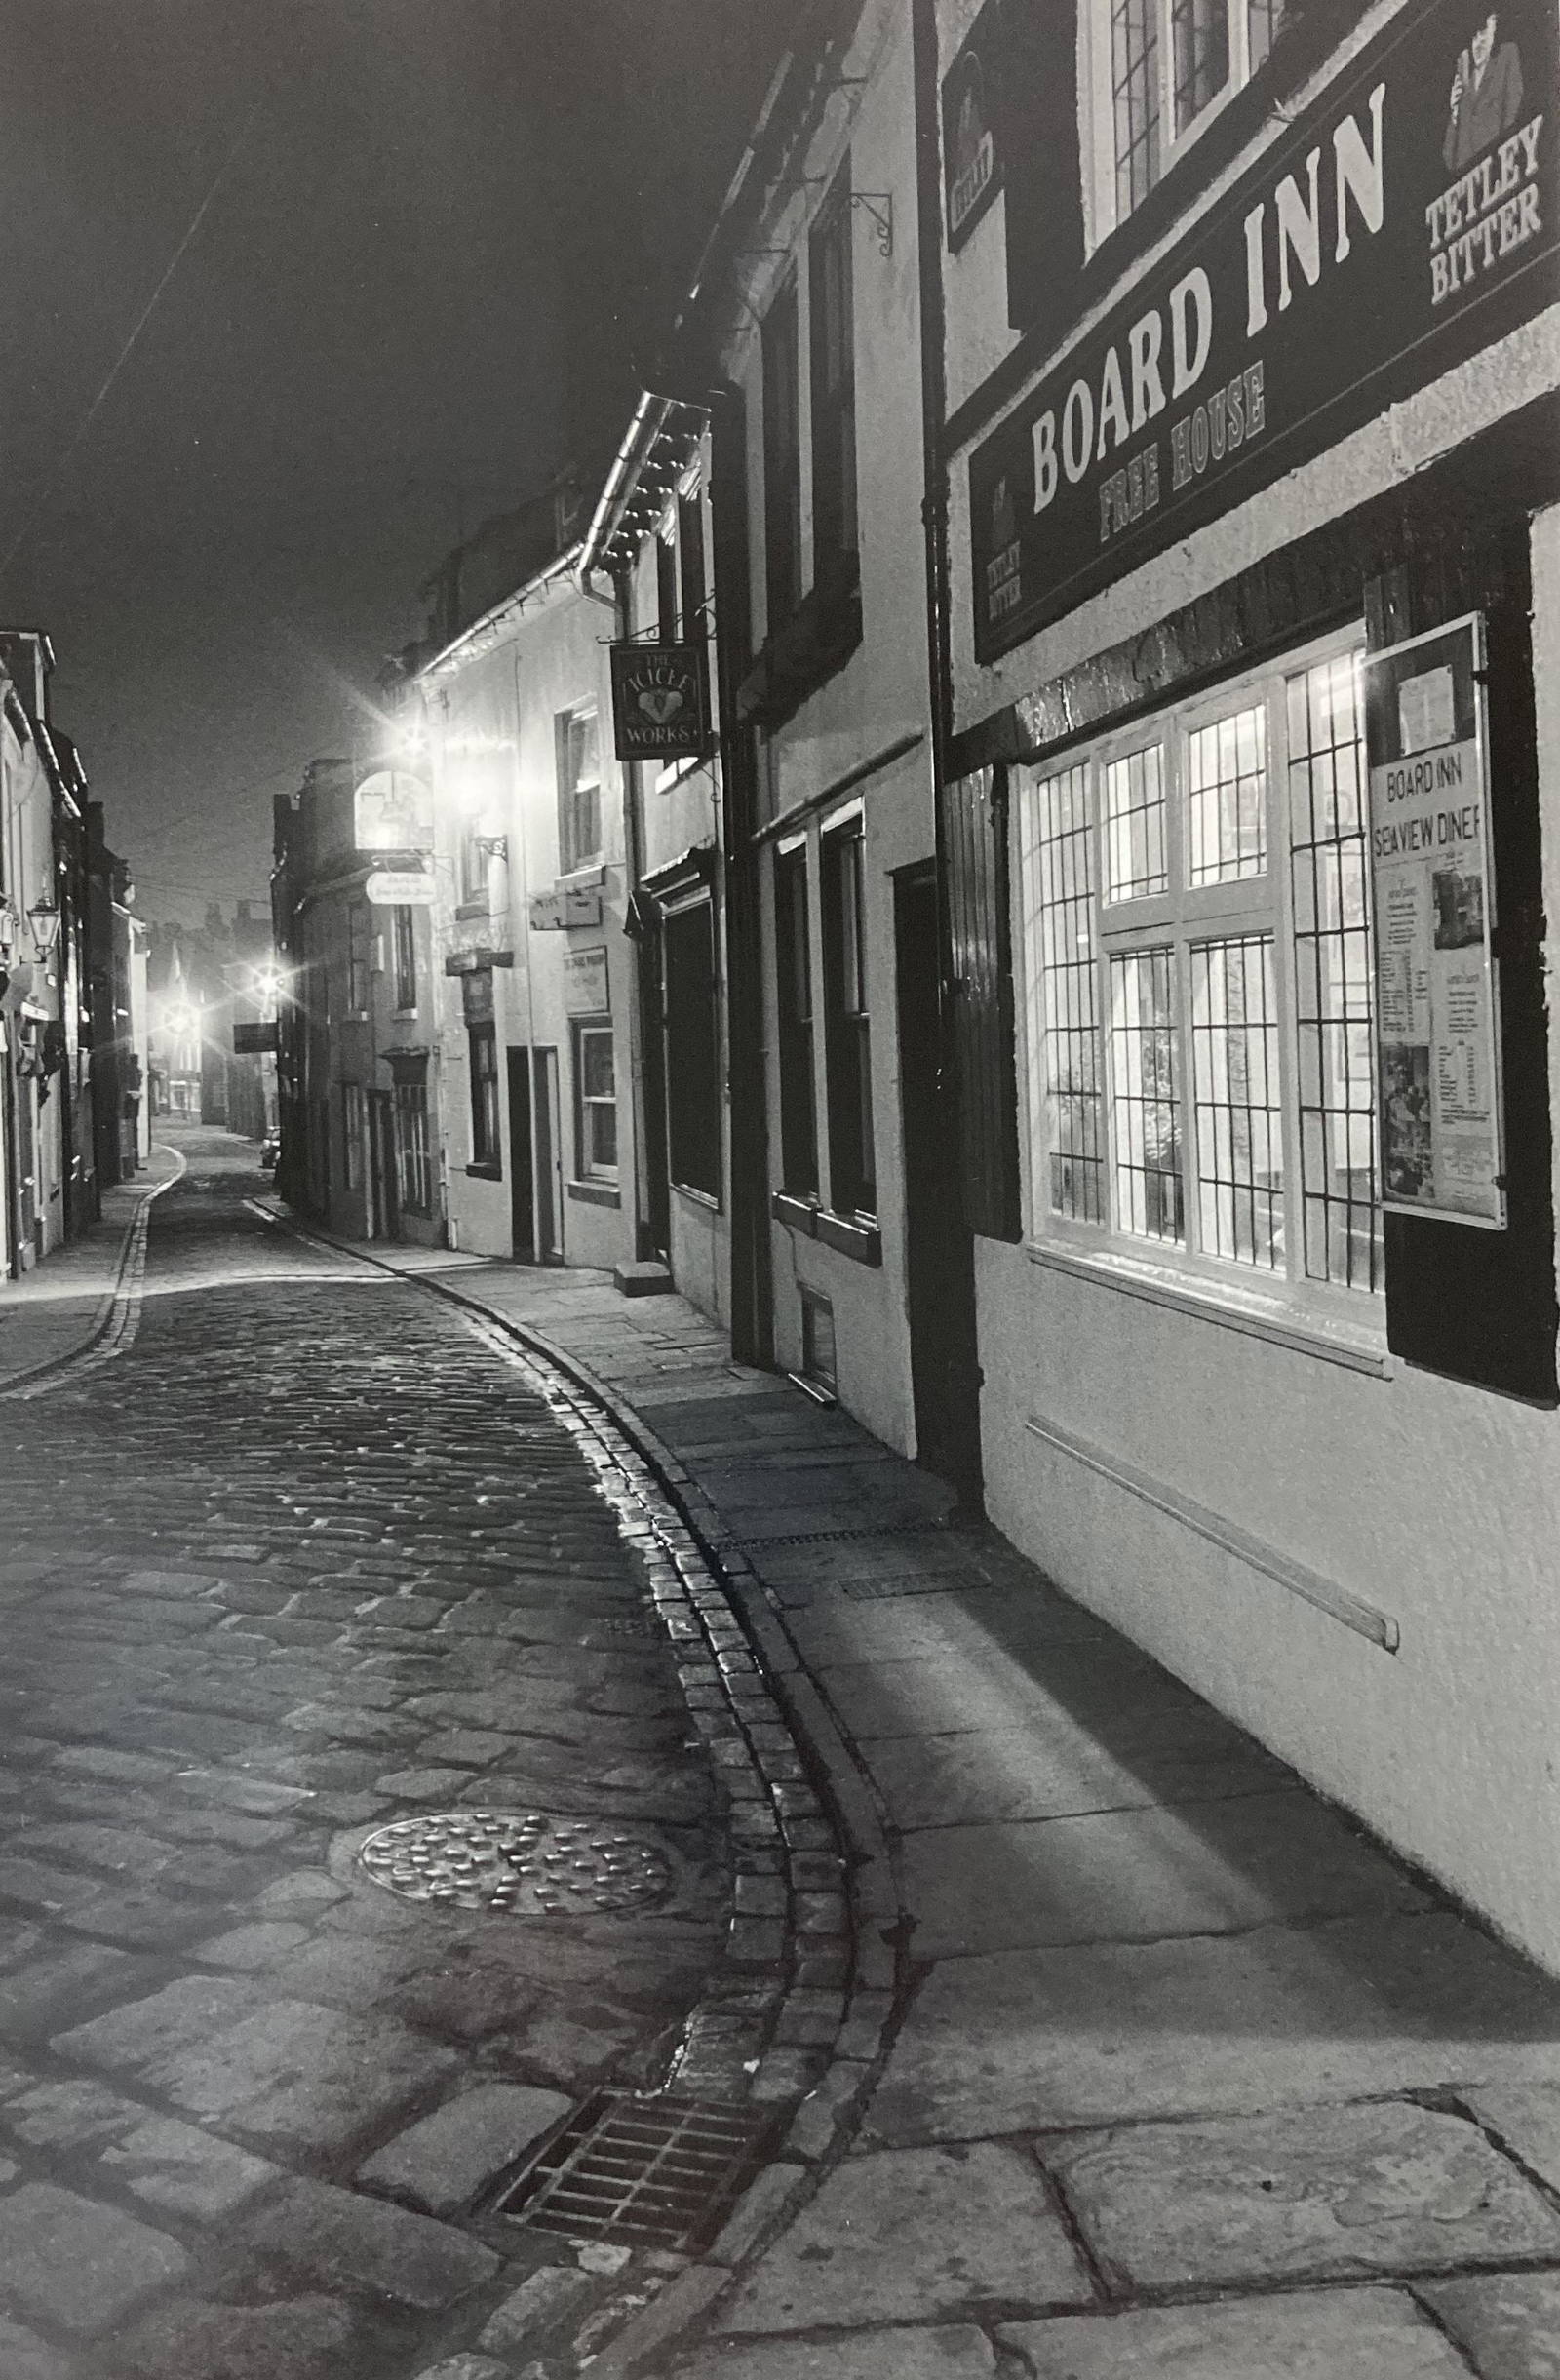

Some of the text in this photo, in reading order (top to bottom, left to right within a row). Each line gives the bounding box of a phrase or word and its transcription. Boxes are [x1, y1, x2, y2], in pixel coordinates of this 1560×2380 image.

[1425, 113, 1543, 250] TETLEY
[1429, 182, 1542, 306] BITTER
[1032, 266, 1213, 515] BOARD
[1244, 82, 1386, 338] INN
[1099, 359, 1266, 543] FREE HOUSE
[626, 725, 690, 743] WORKS
[1386, 751, 1462, 803] BOARD INN
